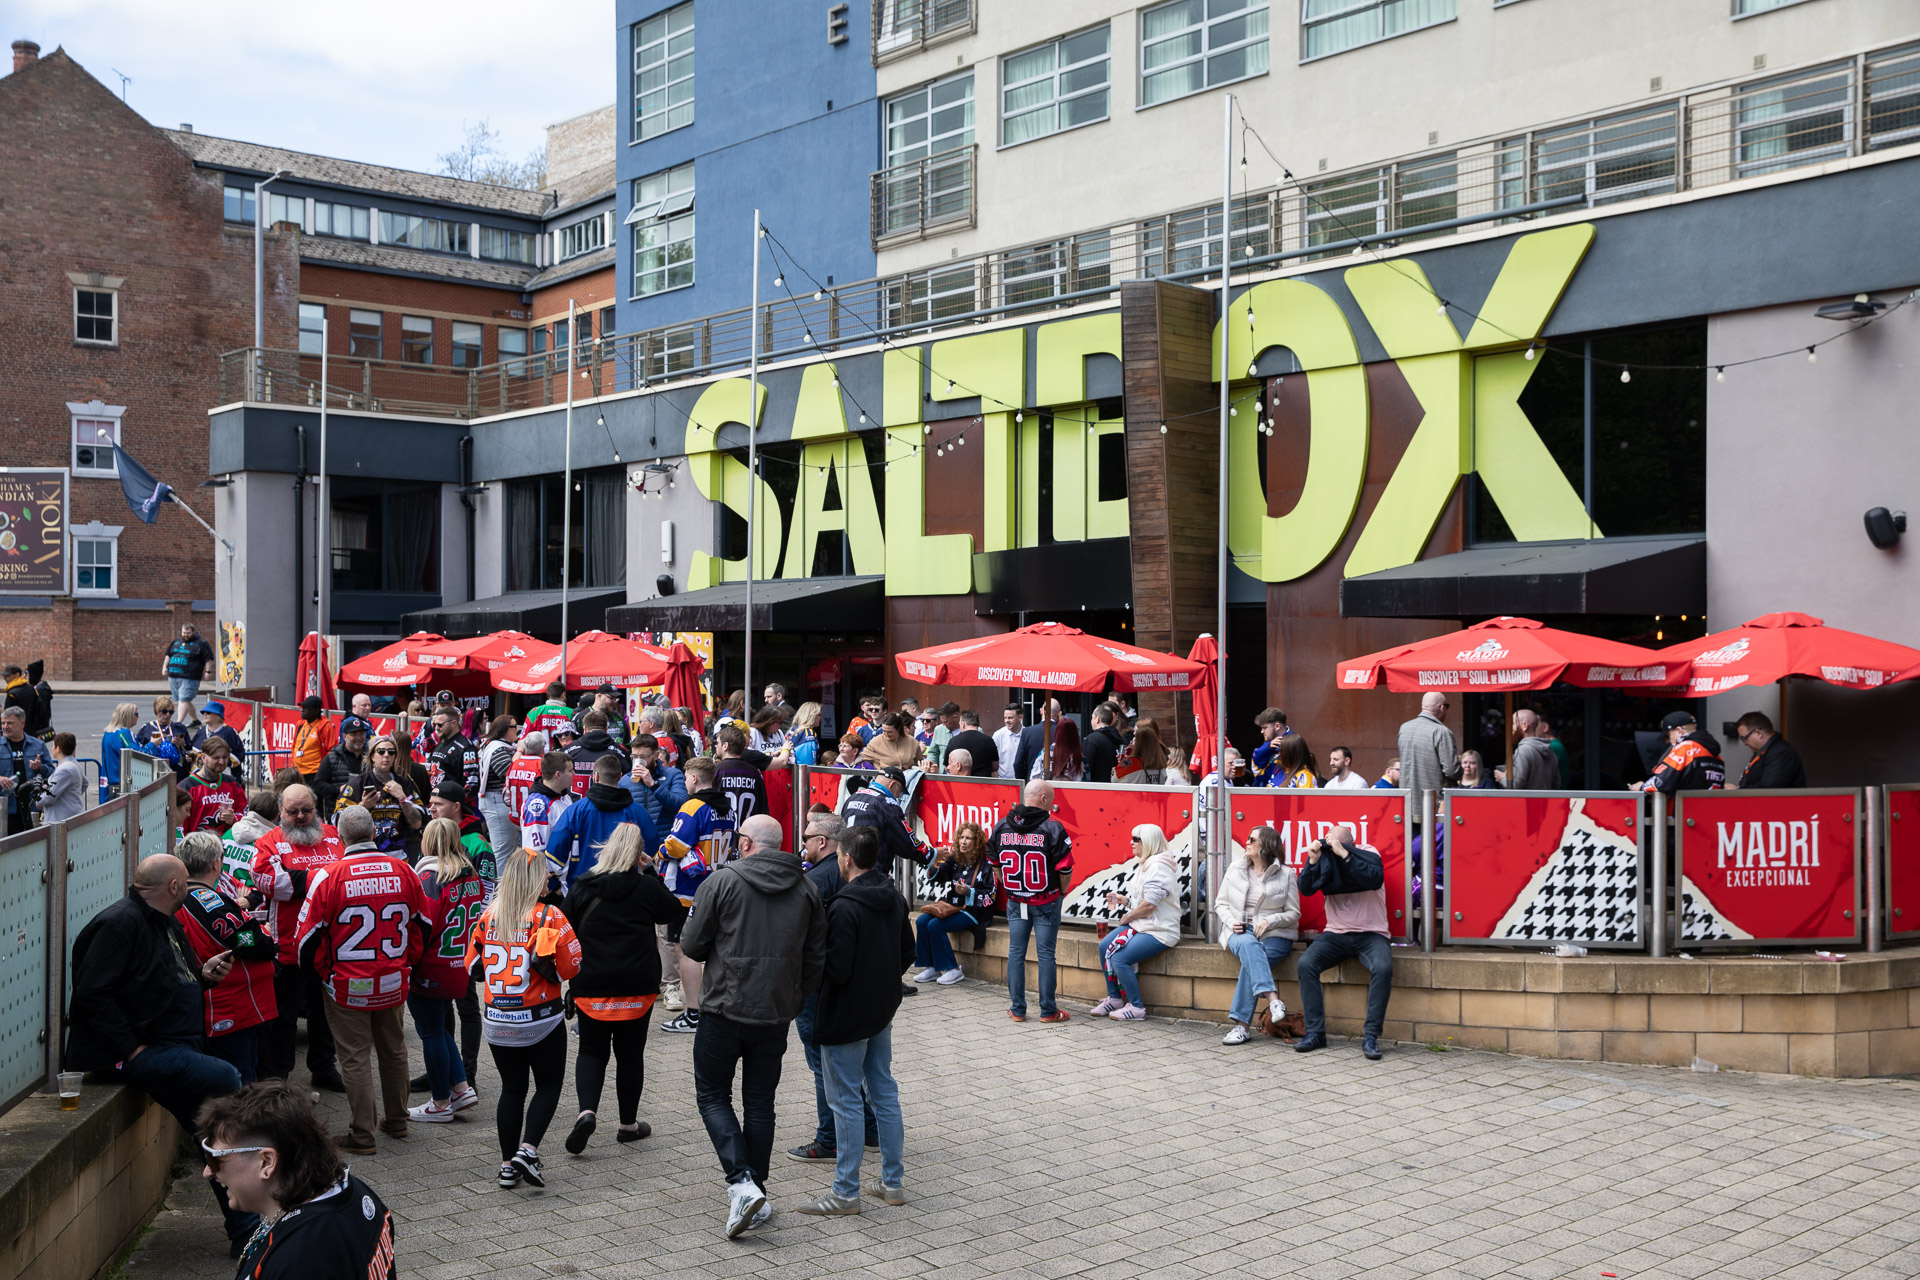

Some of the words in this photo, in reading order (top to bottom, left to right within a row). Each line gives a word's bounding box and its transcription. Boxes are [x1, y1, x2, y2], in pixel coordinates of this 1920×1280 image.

[580, 676, 605, 687] DISCOVER
[611, 676, 624, 685] SOUL
[628, 674, 649, 684] MADRID
[978, 666, 1013, 682] DISCOVER
[1014, 669, 1022, 677] THE
[1021, 670, 1041, 684] SOUL
[1047, 671, 1077, 686] MADRID
[1132, 673, 1153, 687] DISCOVER
[1157, 673, 1169, 686] SOUL
[1172, 672, 1189, 686] MADRID
[1418, 670, 1459, 686] DISCOVER
[1459, 670, 1468, 679] THE
[1468, 670, 1491, 685] SOUL
[1498, 669, 1531, 685] MADRID
[1587, 666, 1615, 681] DISCOVER
[1620, 667, 1636, 681] SOUL
[1641, 666, 1666, 680] MADRID
[1695, 677, 1713, 692] SOUL
[1719, 674, 1750, 690] MADRID
[1821, 665, 1859, 683] DISCOVER
[1864, 670, 1883, 686] SOUL
[463, 751, 477, 764] 88
[722, 777, 756, 789] TENDECK
[1000, 833, 1044, 847] FOURNIER
[1717, 813, 1820, 869] MADRÍ
[479, 860, 495, 879] 33
[999, 850, 1048, 892] 20
[1726, 869, 1811, 888] EXCEPCIONAL
[344, 876, 402, 898] BIRBRAER
[212, 912, 244, 939] 21
[336, 902, 410, 961] 23
[484, 944, 531, 995] 23
